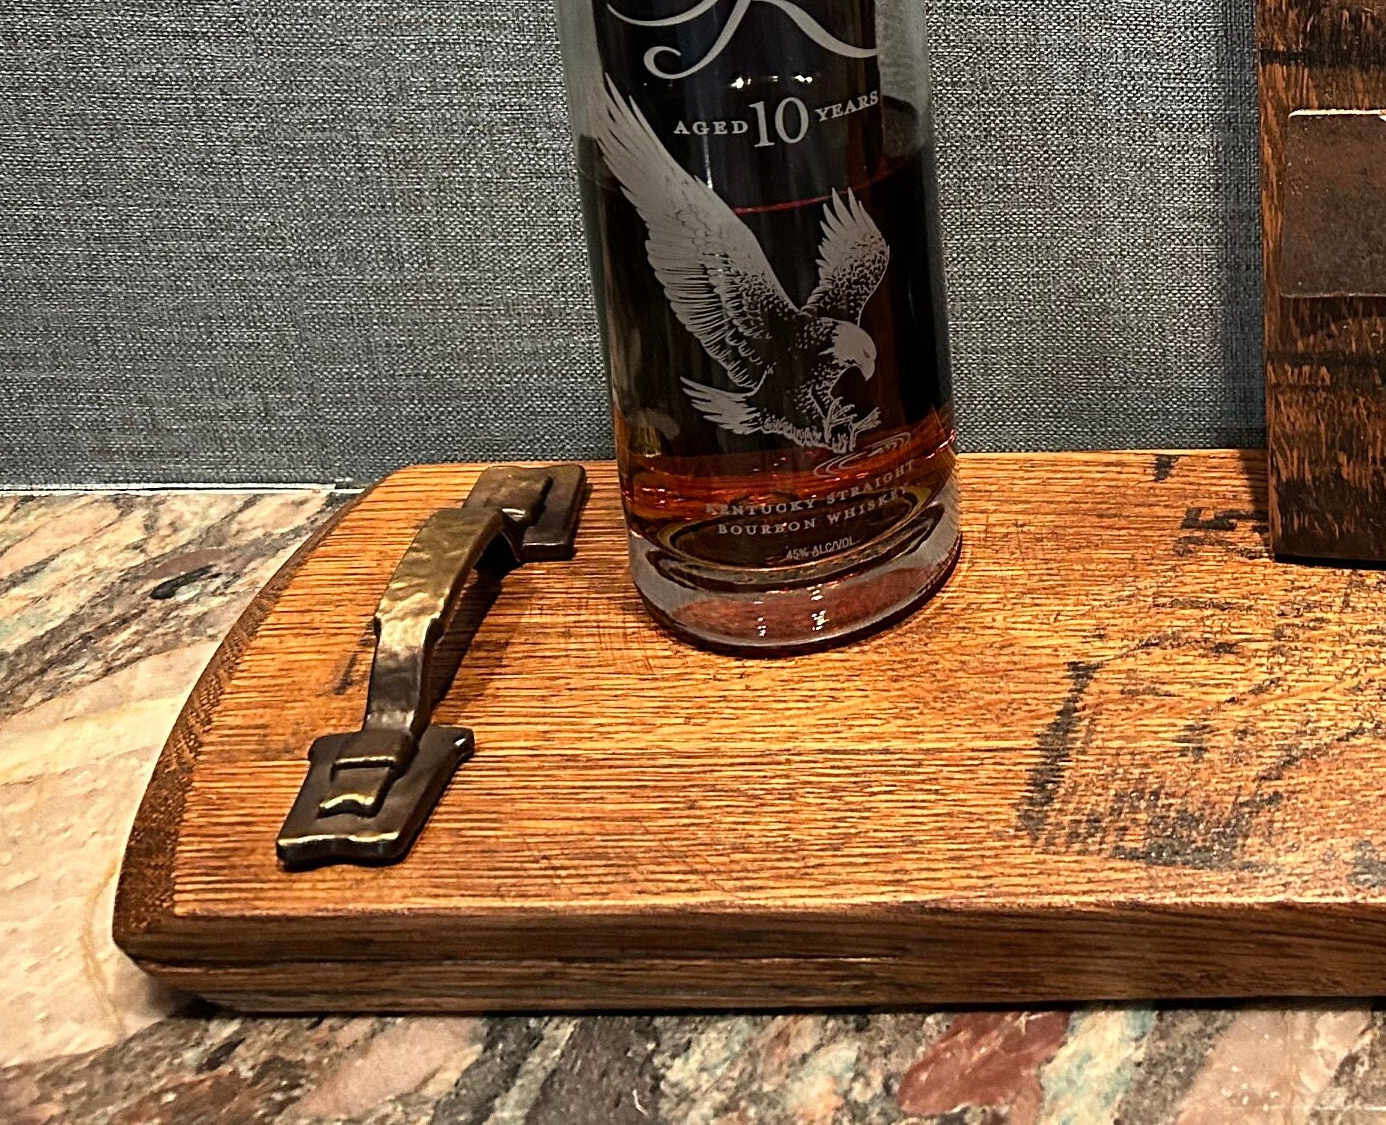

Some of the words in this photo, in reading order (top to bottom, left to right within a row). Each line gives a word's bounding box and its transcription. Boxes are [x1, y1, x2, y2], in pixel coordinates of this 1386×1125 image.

[673, 119, 749, 136] AGED
[749, 95, 810, 149] 10
[813, 89, 881, 123] YEARS
[705, 498, 816, 517] KENTUCKY
[826, 459, 915, 505] STRAIGHT
[718, 518, 816, 536] BOURBON
[826, 484, 909, 525] WHISKEY
[785, 546, 810, 561] 45%
[812, 535, 857, 557] ALC/VOL
